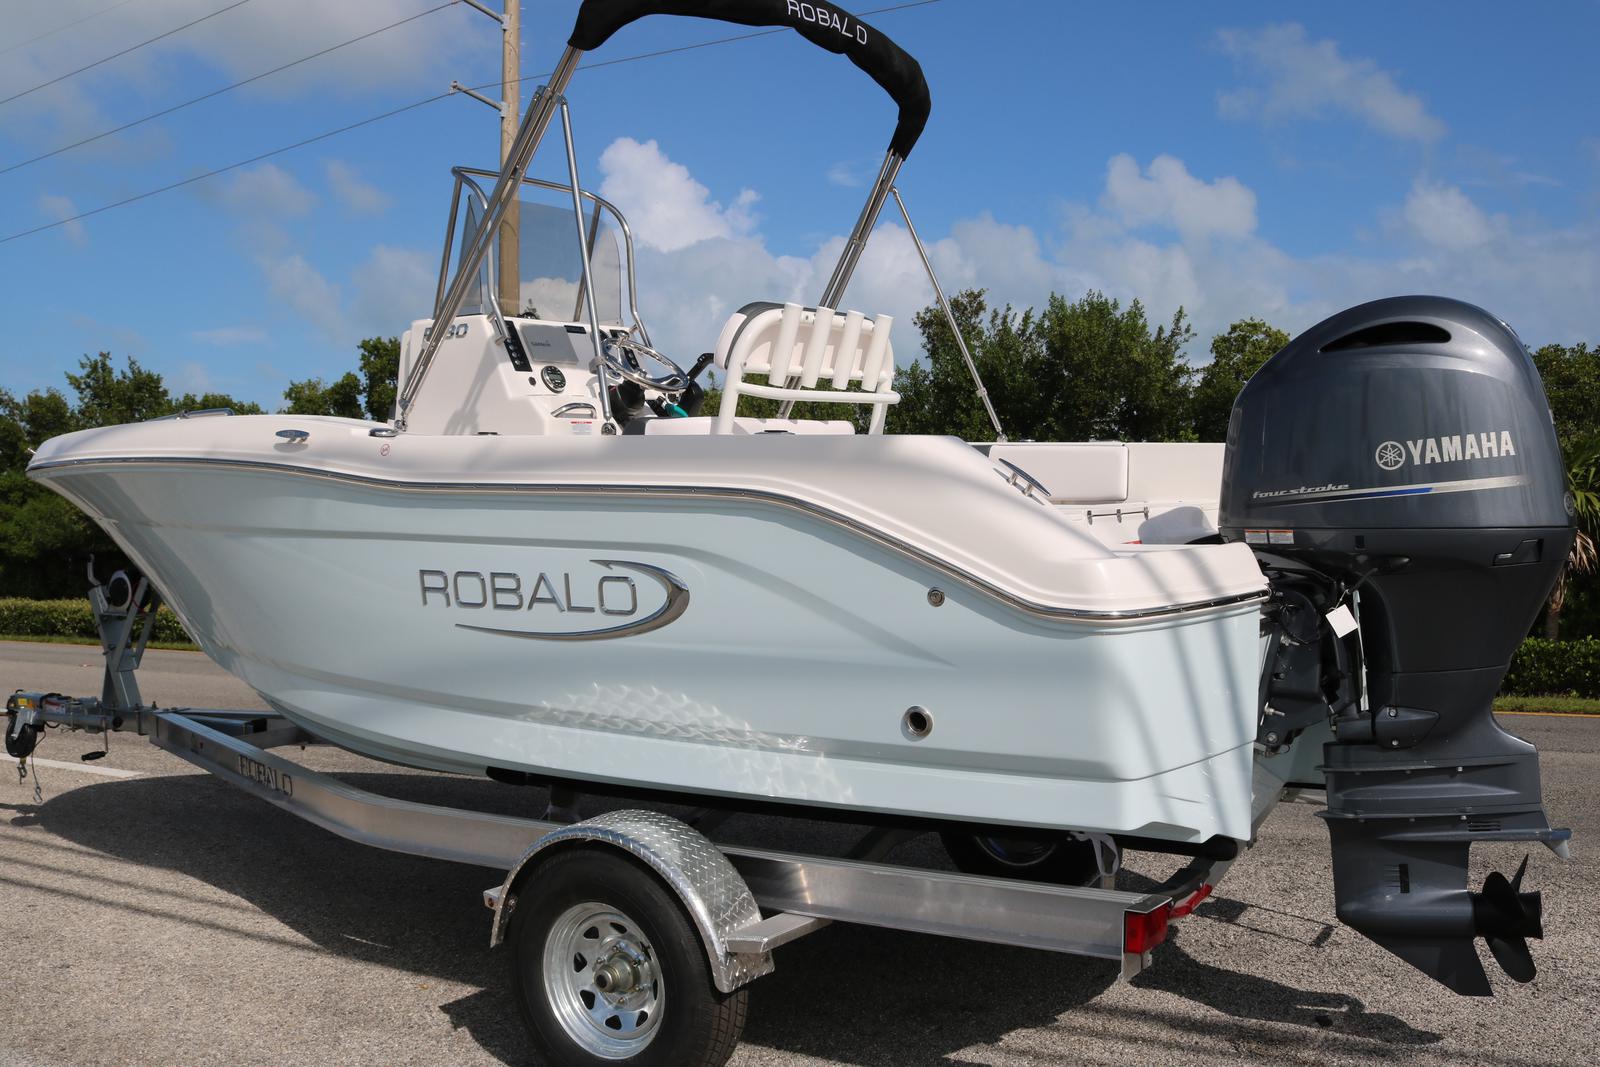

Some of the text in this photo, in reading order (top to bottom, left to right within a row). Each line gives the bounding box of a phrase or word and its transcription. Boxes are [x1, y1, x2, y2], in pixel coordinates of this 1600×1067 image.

[786, 0, 867, 45] ROBALO
[1406, 430, 1516, 466] YAMAHA
[419, 569, 637, 616] ROBALO
